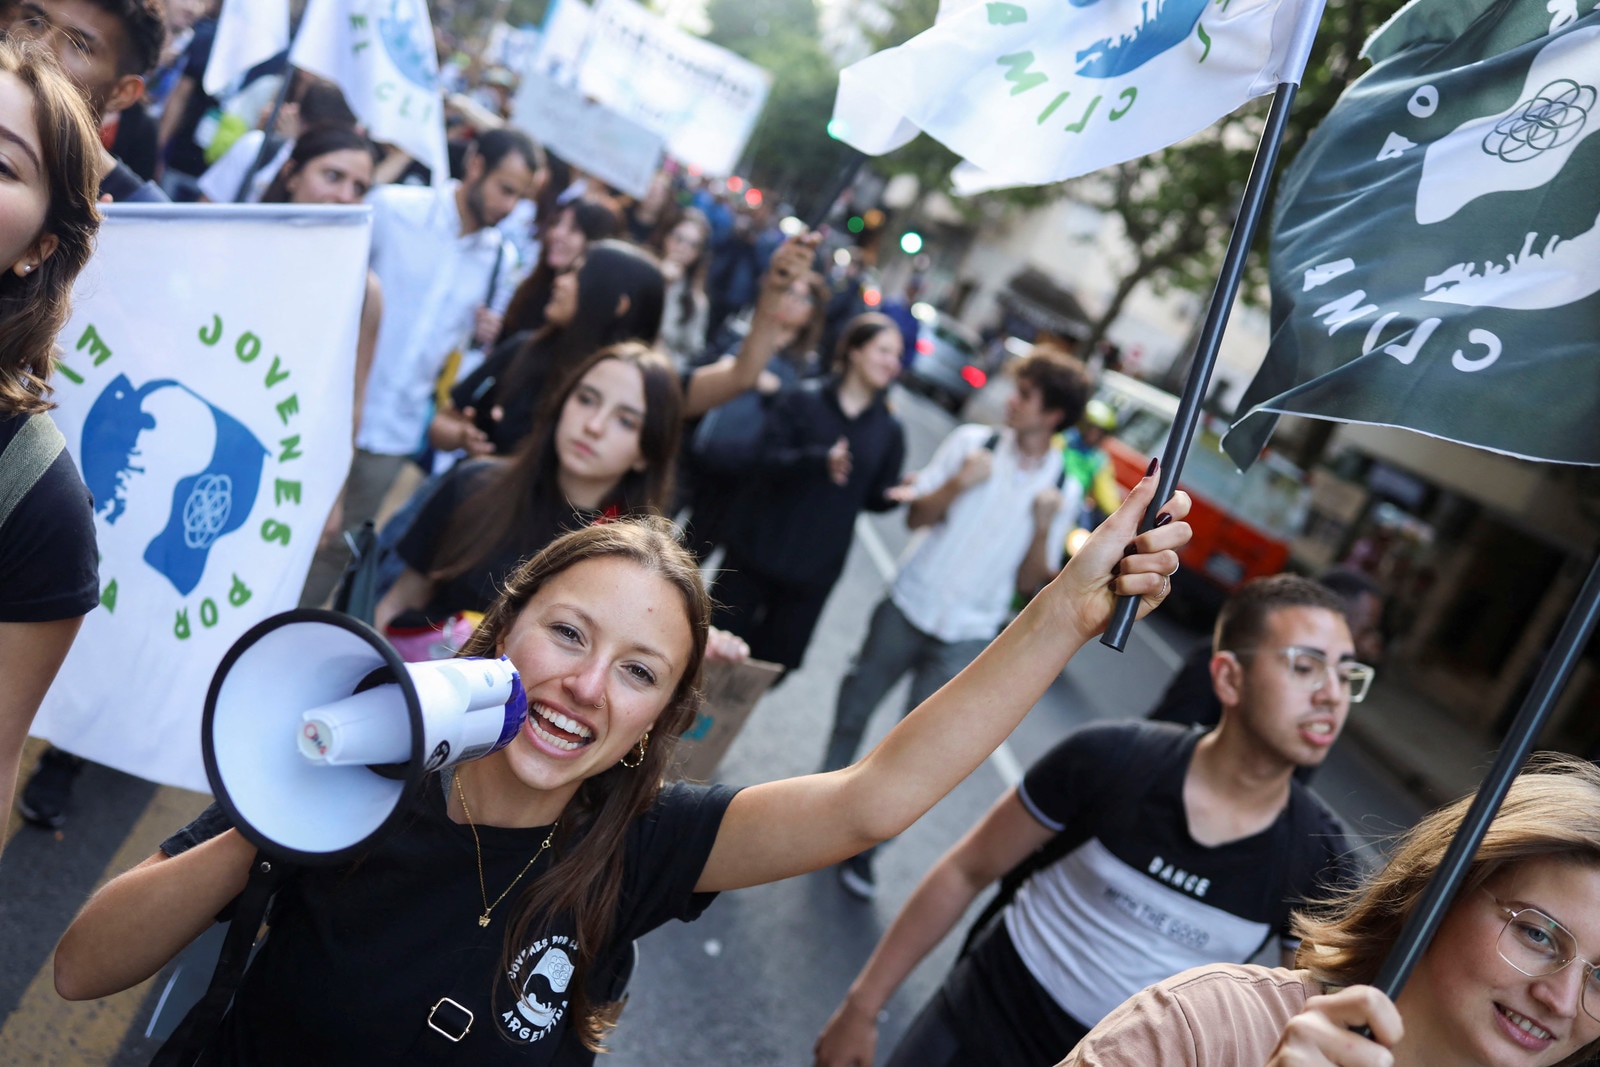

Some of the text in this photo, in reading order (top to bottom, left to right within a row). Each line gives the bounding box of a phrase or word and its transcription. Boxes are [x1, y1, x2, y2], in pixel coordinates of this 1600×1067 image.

[173, 313, 303, 640] JOVENES POR
[1149, 856, 1210, 897] DANCE
